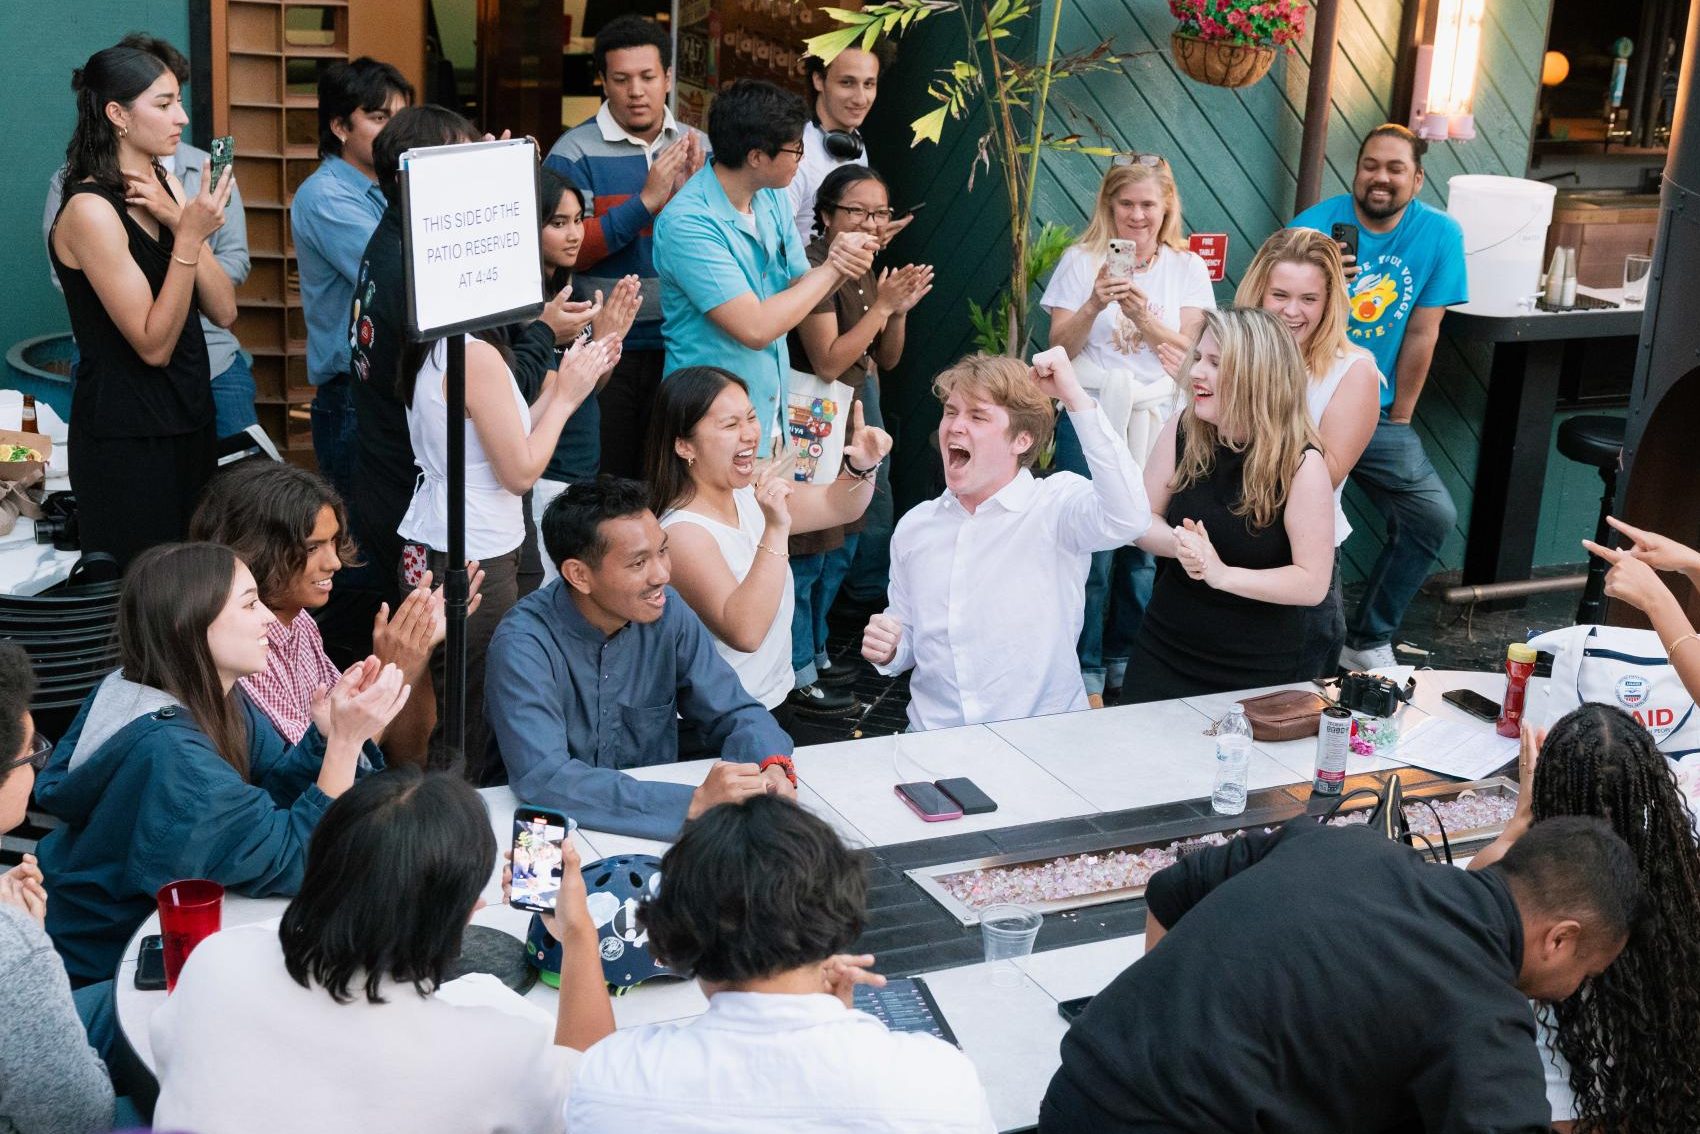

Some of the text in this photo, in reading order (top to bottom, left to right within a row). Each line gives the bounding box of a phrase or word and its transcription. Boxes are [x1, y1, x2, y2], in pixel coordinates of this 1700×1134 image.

[422, 201, 520, 233] THIS SIDE OF THE
[426, 231, 520, 265] PATIO RESERVED
[1201, 237, 1214, 246] FIRE
[458, 266, 498, 288] AT 4:45
[1393, 265, 1413, 320] VOYAGE
[1632, 708, 1674, 728] AID
